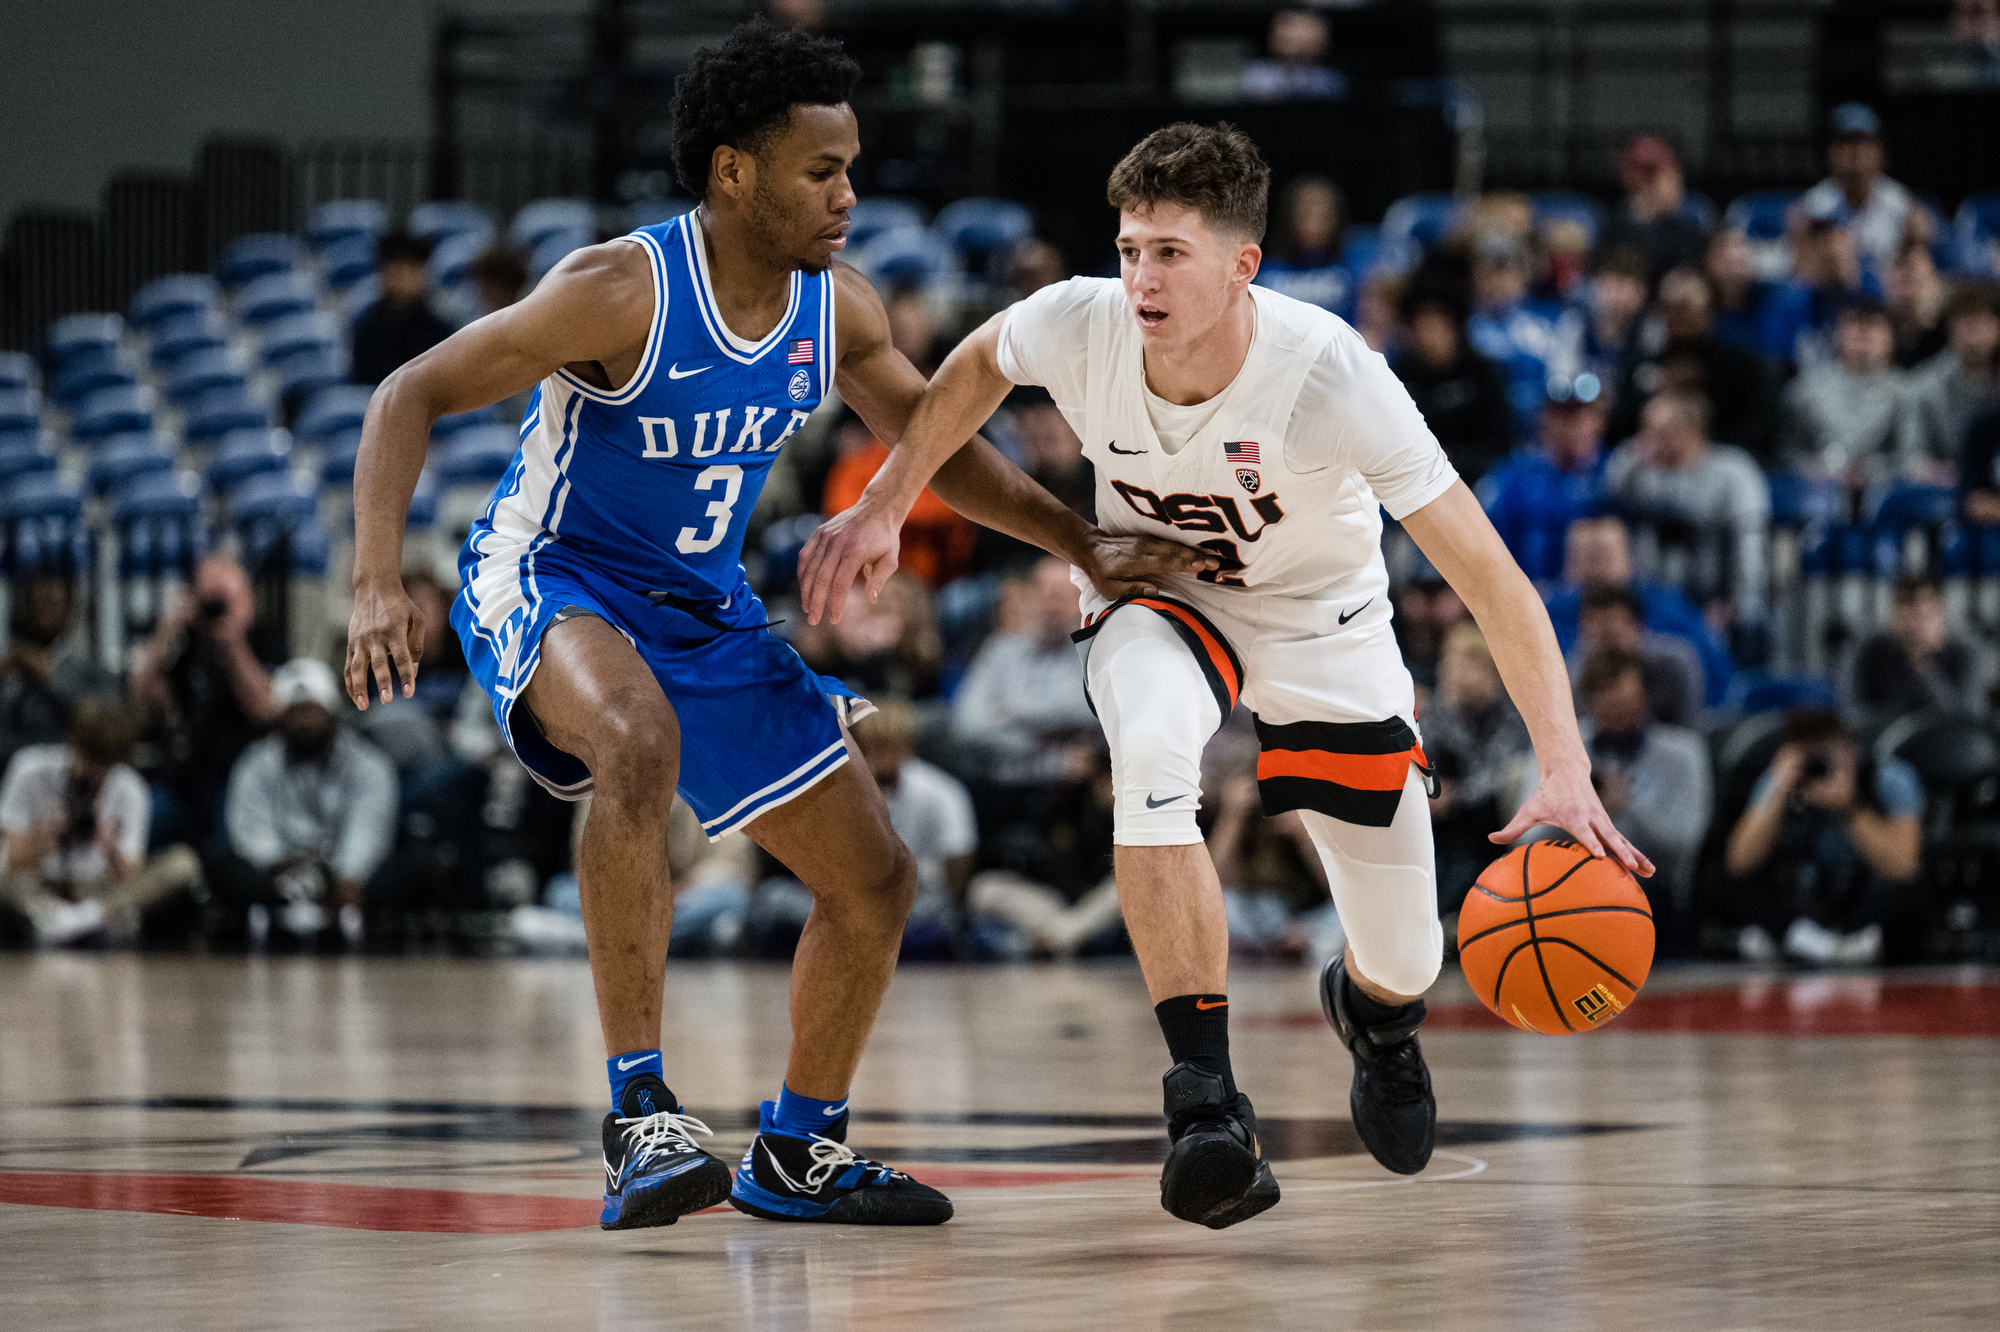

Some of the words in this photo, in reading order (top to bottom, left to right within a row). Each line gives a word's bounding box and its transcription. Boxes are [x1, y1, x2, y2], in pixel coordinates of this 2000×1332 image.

[1237, 470, 1258, 485] PAC
[1244, 480, 1257, 490] 12
[675, 464, 744, 554] 3
[1110, 479, 1285, 542] OSU
[1196, 538, 1249, 588] 2
